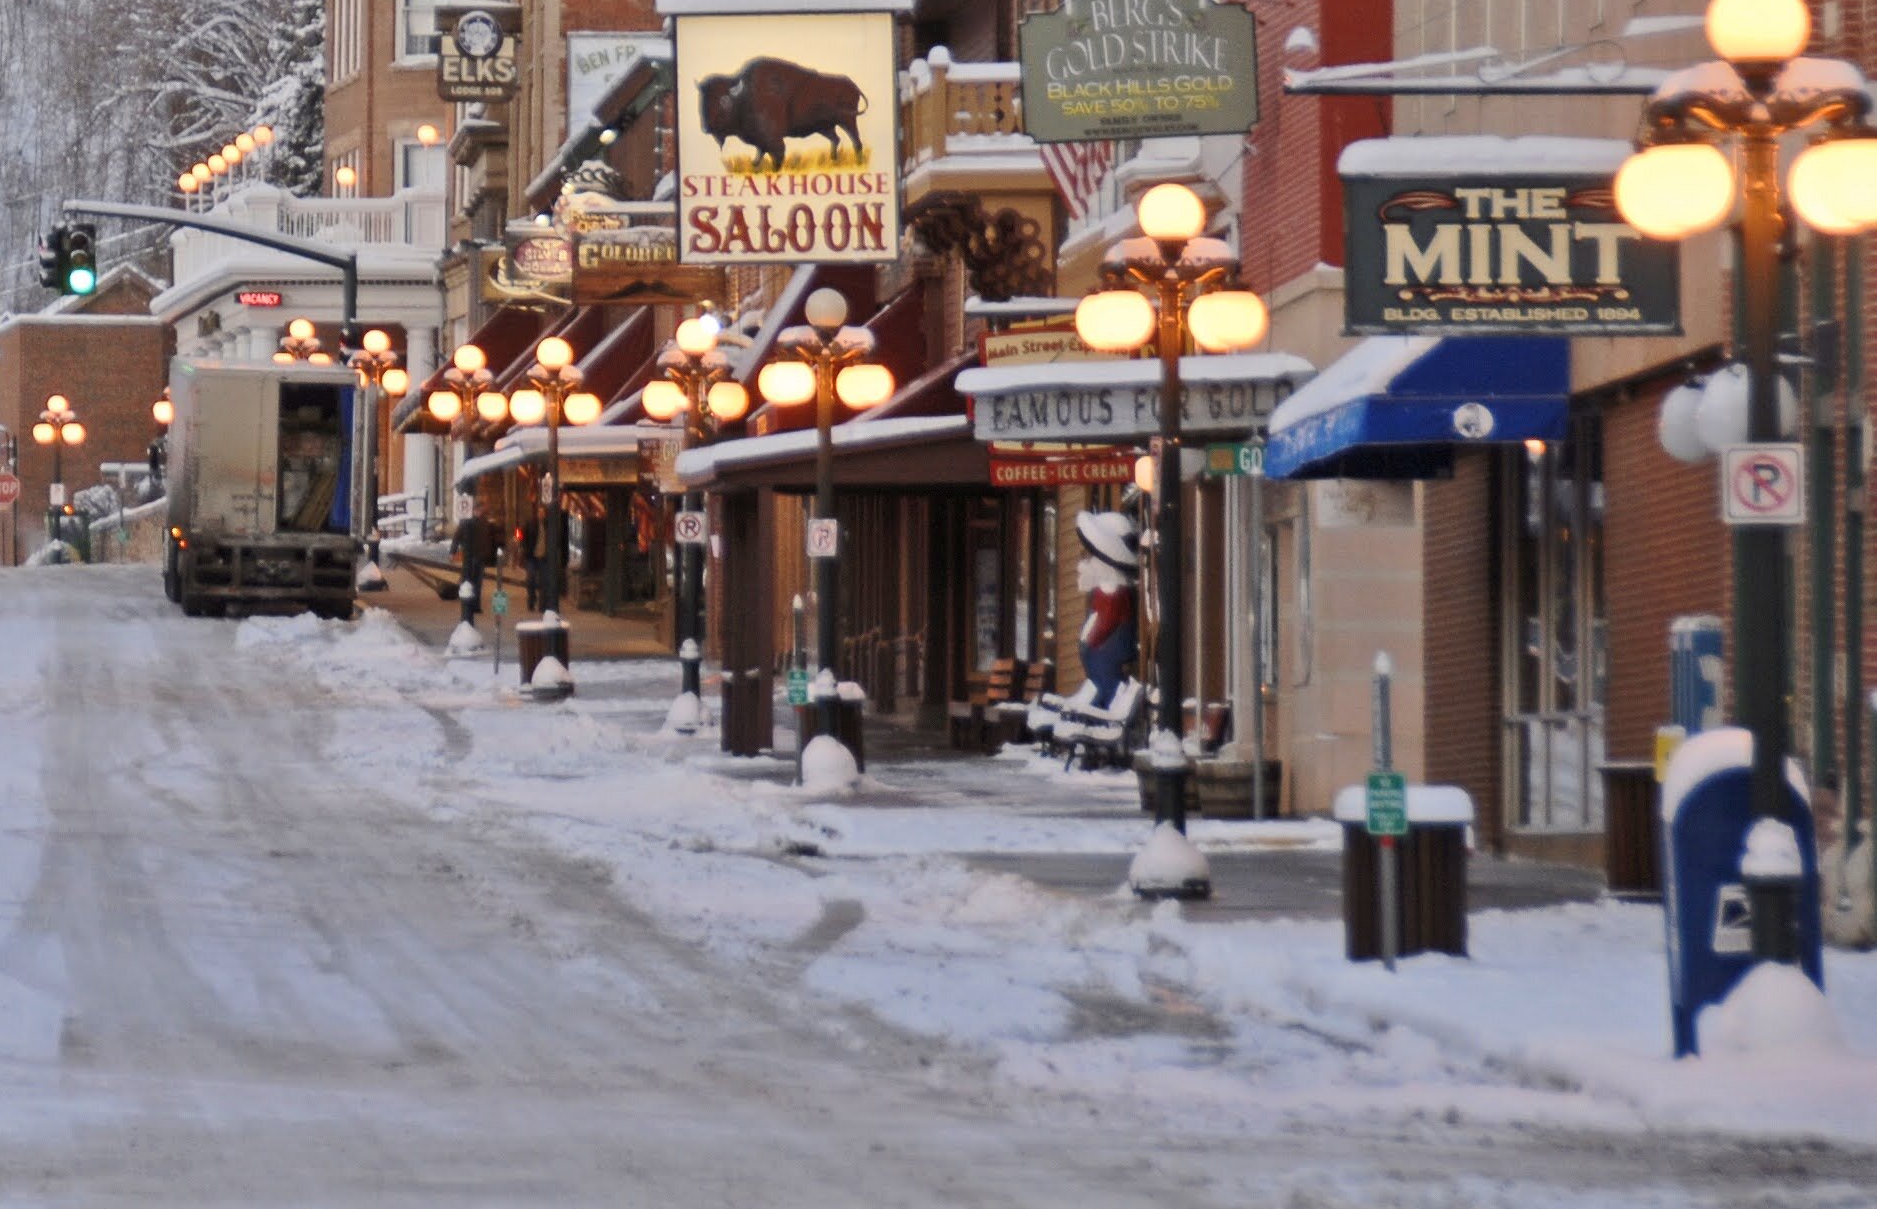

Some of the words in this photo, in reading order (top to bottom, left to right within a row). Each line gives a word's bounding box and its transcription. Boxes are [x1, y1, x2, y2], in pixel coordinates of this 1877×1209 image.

[1046, 32, 1126, 80] GOLD
[1131, 29, 1230, 73] STRIKE
[443, 57, 514, 83] ELKS
[1046, 80, 1112, 101] BLACK
[1115, 76, 1171, 96] HILLS
[1174, 74, 1234, 92] GOLD
[1061, 99, 1107, 116] SAVE
[1154, 95, 1180, 111] TO
[683, 171, 891, 197] STEAKHOUSE
[1455, 187, 1567, 220] THE
[688, 202, 888, 254] SALOON
[1383, 222, 1643, 285] MINT
[240, 293, 280, 305] VACANCY
[1383, 307, 1442, 321] BLDG.
[1450, 307, 1589, 321] ESTABLISHED
[987, 344, 1018, 360] Main
[1022, 339, 1064, 355] Street
[992, 389, 1114, 432] FAMOUS
[996, 465, 1048, 481] COFFEE
[1057, 464, 1079, 479] ICE
[1083, 461, 1130, 479] CREAM
